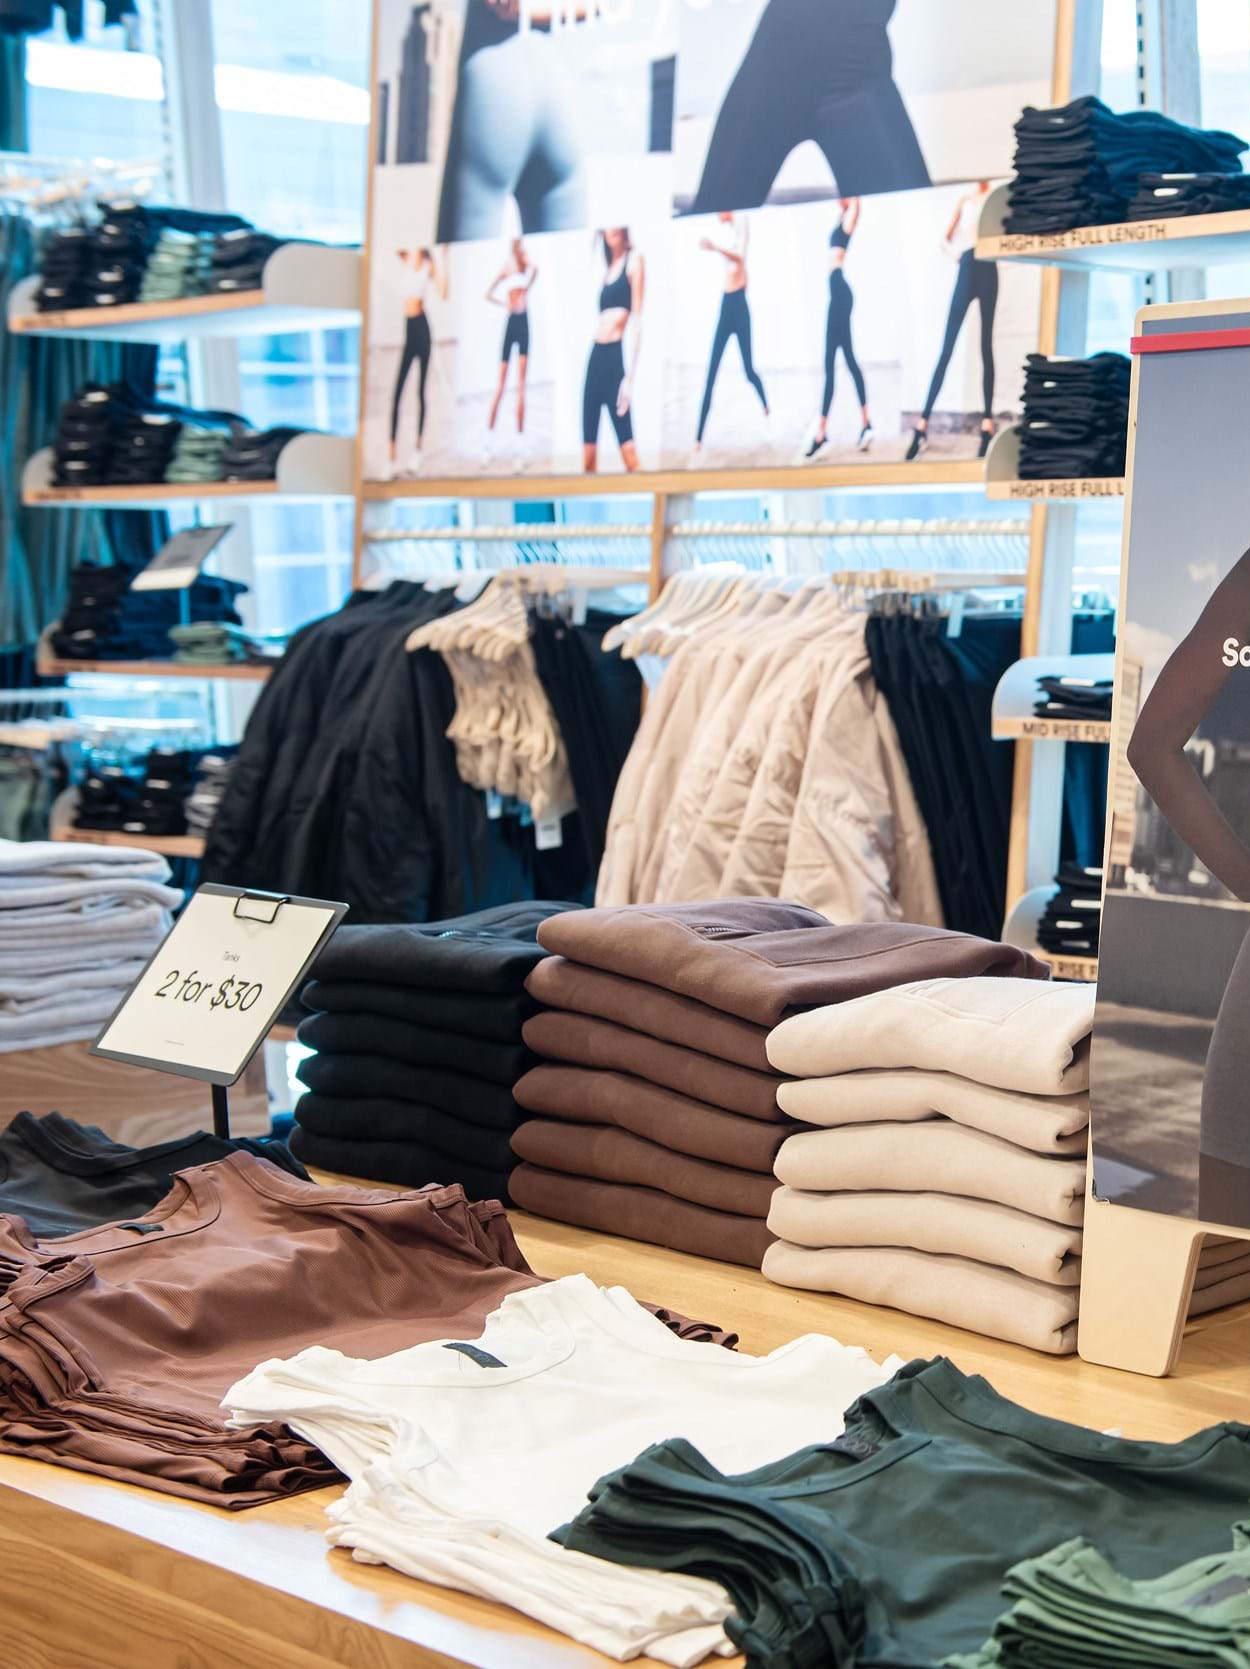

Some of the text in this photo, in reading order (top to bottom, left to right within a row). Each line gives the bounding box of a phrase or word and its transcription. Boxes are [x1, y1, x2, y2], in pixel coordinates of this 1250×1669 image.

[1000, 223, 1167, 251] HIGH RISE FULL LENGTH
[1009, 482, 1044, 497] HIGH
[1049, 482, 1076, 497] RISE
[1081, 482, 1113, 496] FULL
[1022, 722, 1048, 736] MID
[154, 970, 263, 1012] 2 for $30
